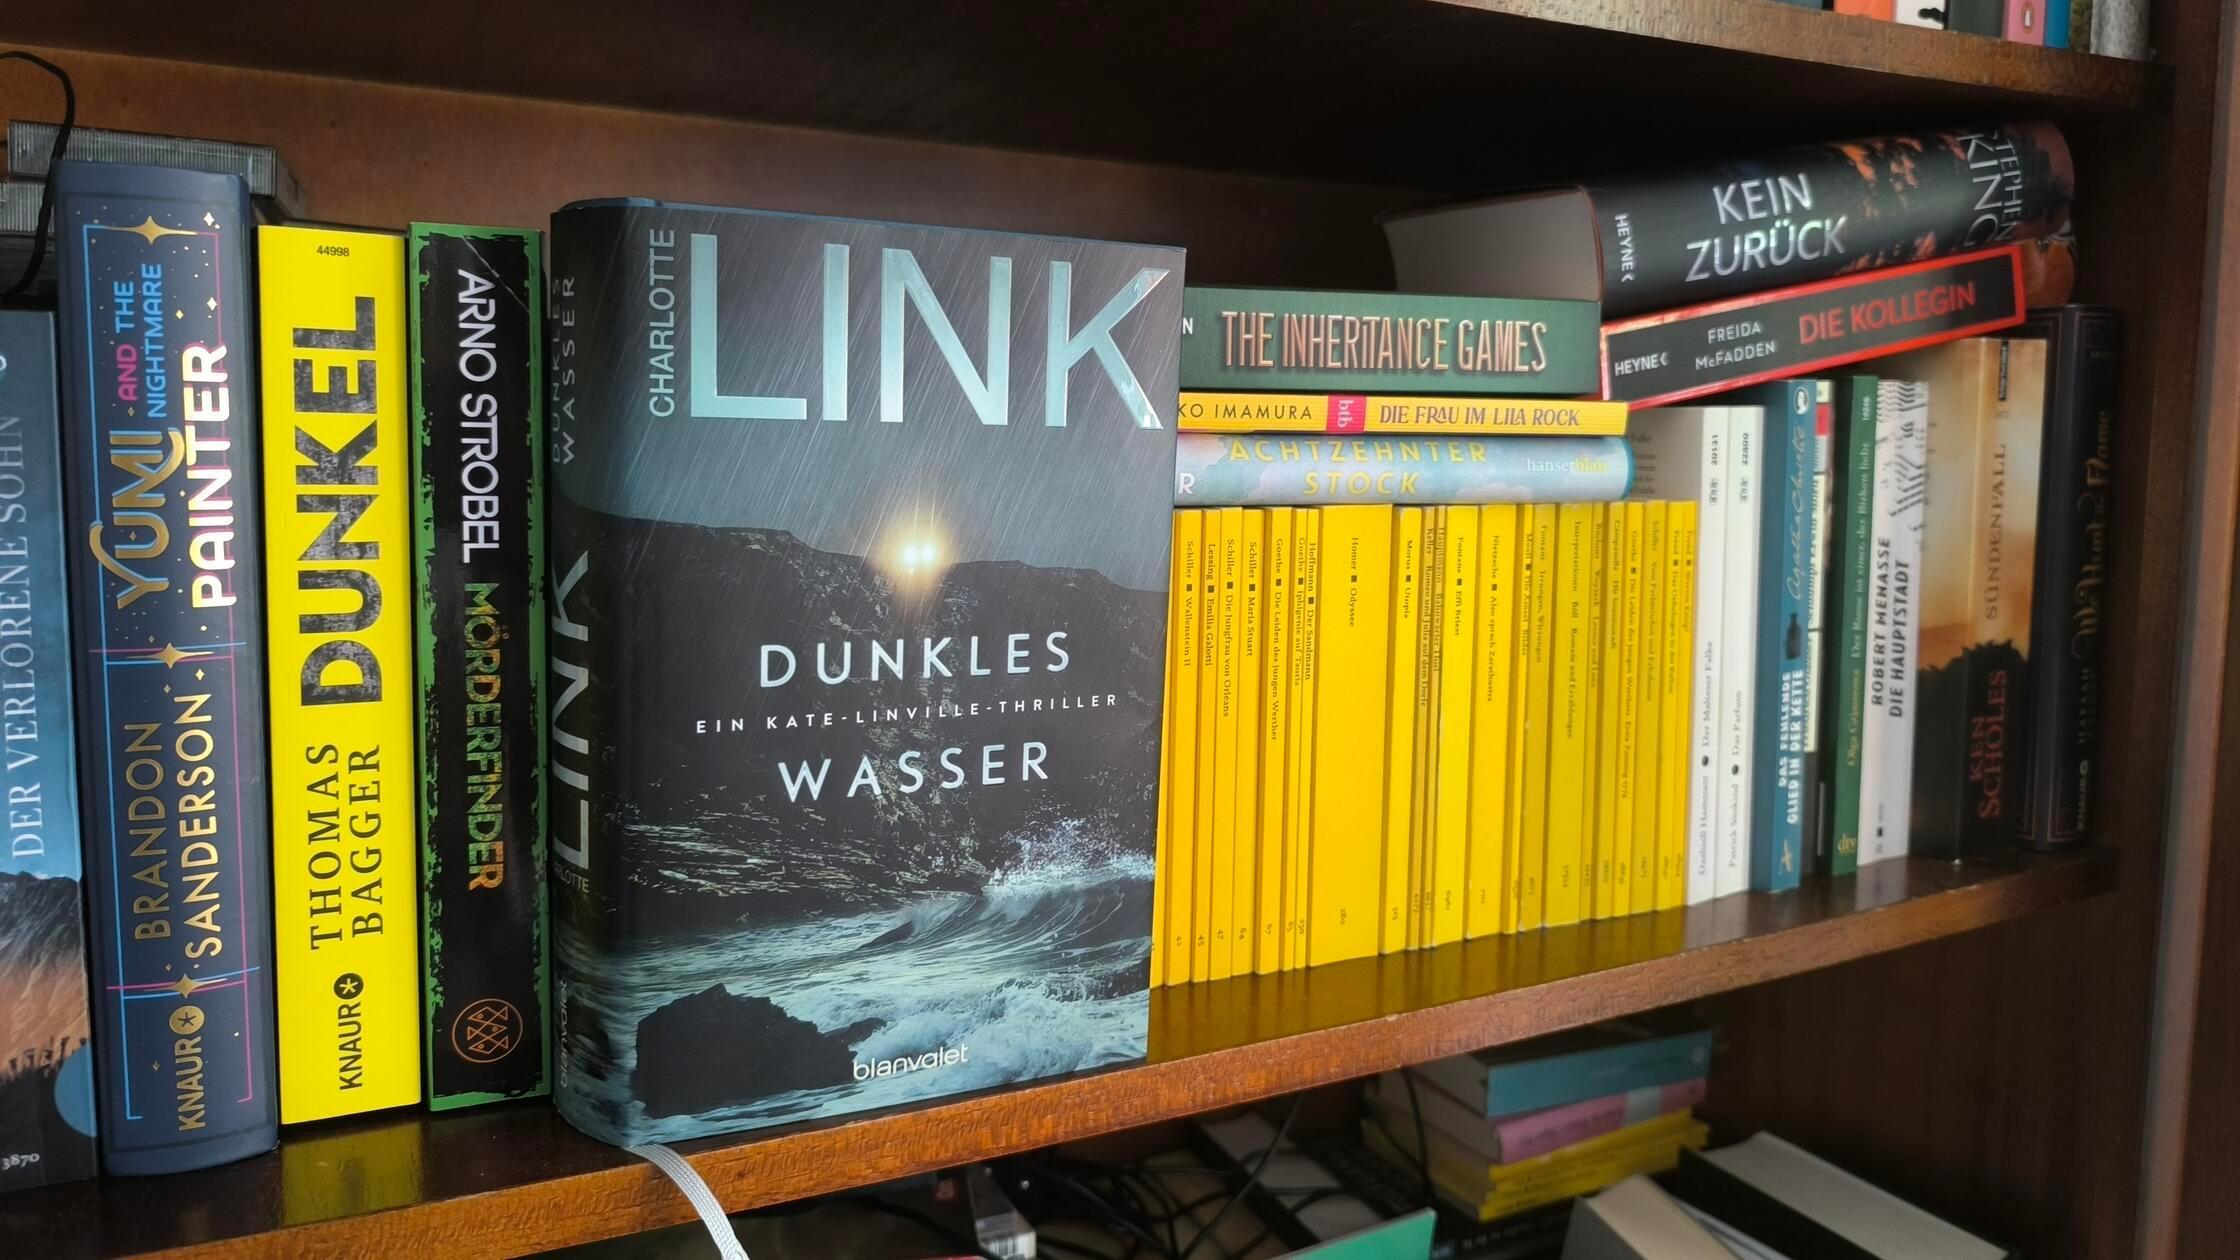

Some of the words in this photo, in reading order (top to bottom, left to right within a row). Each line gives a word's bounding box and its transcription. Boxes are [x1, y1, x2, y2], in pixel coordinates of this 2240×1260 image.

[1713, 173, 1812, 224] KEIN
[316, 246, 350, 257] 44998
[1685, 215, 1848, 282] ZURÜCK
[114, 281, 135, 334] THE
[457, 269, 498, 383] ARNO
[649, 229, 675, 417] CHARLOTTE
[1799, 308, 1844, 345] DIE
[1851, 281, 1977, 331] KOLLEGIN
[141, 263, 167, 418] NIGHTMARE
[690, 233, 1171, 430] LINK
[1221, 311, 1276, 367] THE
[1282, 312, 1450, 371] INHERITANCE
[1457, 319, 1547, 373] GAMES
[1707, 320, 1764, 344] FREIDA
[116, 343, 138, 401] AND
[552, 278, 560, 463] DUNKLES
[562, 276, 575, 464] WASSER
[1695, 340, 1778, 371] McFADDEN
[1214, 404, 1313, 420] IMAMURA
[1338, 399, 1355, 428] btb
[1379, 405, 1409, 424] DIE
[1414, 405, 1460, 425] FRAU
[1465, 407, 1486, 425] IM
[1492, 408, 1527, 426] LILA
[1532, 409, 1580, 427] ROCK
[0, 417, 26, 523] SOHN
[1228, 437, 1488, 464] ACHTZEHNTER
[181, 341, 237, 608] PAINTER
[460, 393, 501, 563] STROBEL
[1303, 471, 1420, 496] STOCK
[90, 427, 185, 610] YUMI
[292, 296, 382, 706] DUNKEL
[1351, 537, 1359, 571] Homer
[1983, 444, 2006, 620] SÜNDENFALL
[1185, 540, 1194, 578] Schiller
[1206, 543, 1216, 580] Lessing
[1226, 539, 1234, 577] Schiller
[1248, 542, 1257, 579] Schiller
[1275, 538, 1284, 574] Goethe
[1307, 542, 1317, 592] Hoffmann
[1405, 540, 1413, 570] Morus
[1456, 537, 1464, 573] Fontane
[1491, 535, 1500, 579] Nietzsche
[1225, 595, 1233, 610] Die
[1403, 587, 1411, 618] Utopia
[1423, 566, 1432, 596] Romeo
[1873, 537, 1890, 626] MENASSE
[1183, 597, 1193, 656] Wallenstein
[1206, 599, 1215, 630] Emilia
[1247, 597, 1255, 624] Maria
[1274, 611, 1282, 644] Leiden
[1295, 590, 1304, 635] Iphigenie
[1306, 609, 1314, 627] Der
[1348, 588, 1358, 627] Odyssee
[1454, 609, 1462, 636] Briest
[1889, 559, 1909, 681] HAUPTSTADT
[0, 536, 41, 771] VERLORENE
[1205, 633, 1214, 666] Galotti
[1223, 614, 1233, 656] Jungfrau
[1246, 627, 1255, 657] Stuart
[1273, 646, 1281, 662] des
[1305, 630, 1313, 680] Sandmann
[759, 631, 1070, 688] DUNKLES
[1271, 665, 1280, 698] jungen
[1871, 632, 1886, 706] ROBERT
[551, 550, 589, 869] LINK
[696, 717, 745, 734] EIN
[767, 693, 1117, 729] KATE-LINVILLE-THRILLER
[1223, 680, 1232, 717] Orleans
[1779, 672, 1791, 750] FEHLENDE
[1790, 670, 1804, 717] KETTE
[1888, 688, 1904, 718] DIE
[464, 583, 509, 891] MÖRDERFINDER
[1271, 700, 1279, 741] Werther
[1790, 720, 1802, 752] DER
[1789, 758, 1800, 775] IN
[1968, 716, 1985, 781] KEN
[777, 741, 1049, 803] WASSER
[1778, 756, 1788, 787] DAS
[8, 781, 45, 859] DER
[1787, 780, 1799, 824] GLIED
[124, 722, 172, 941] BRANDON
[174, 693, 223, 959] SANDERSON
[305, 743, 343, 950] THOMAS
[348, 745, 384, 938] BAGGER
[853, 1043, 968, 1081] blanvalet
